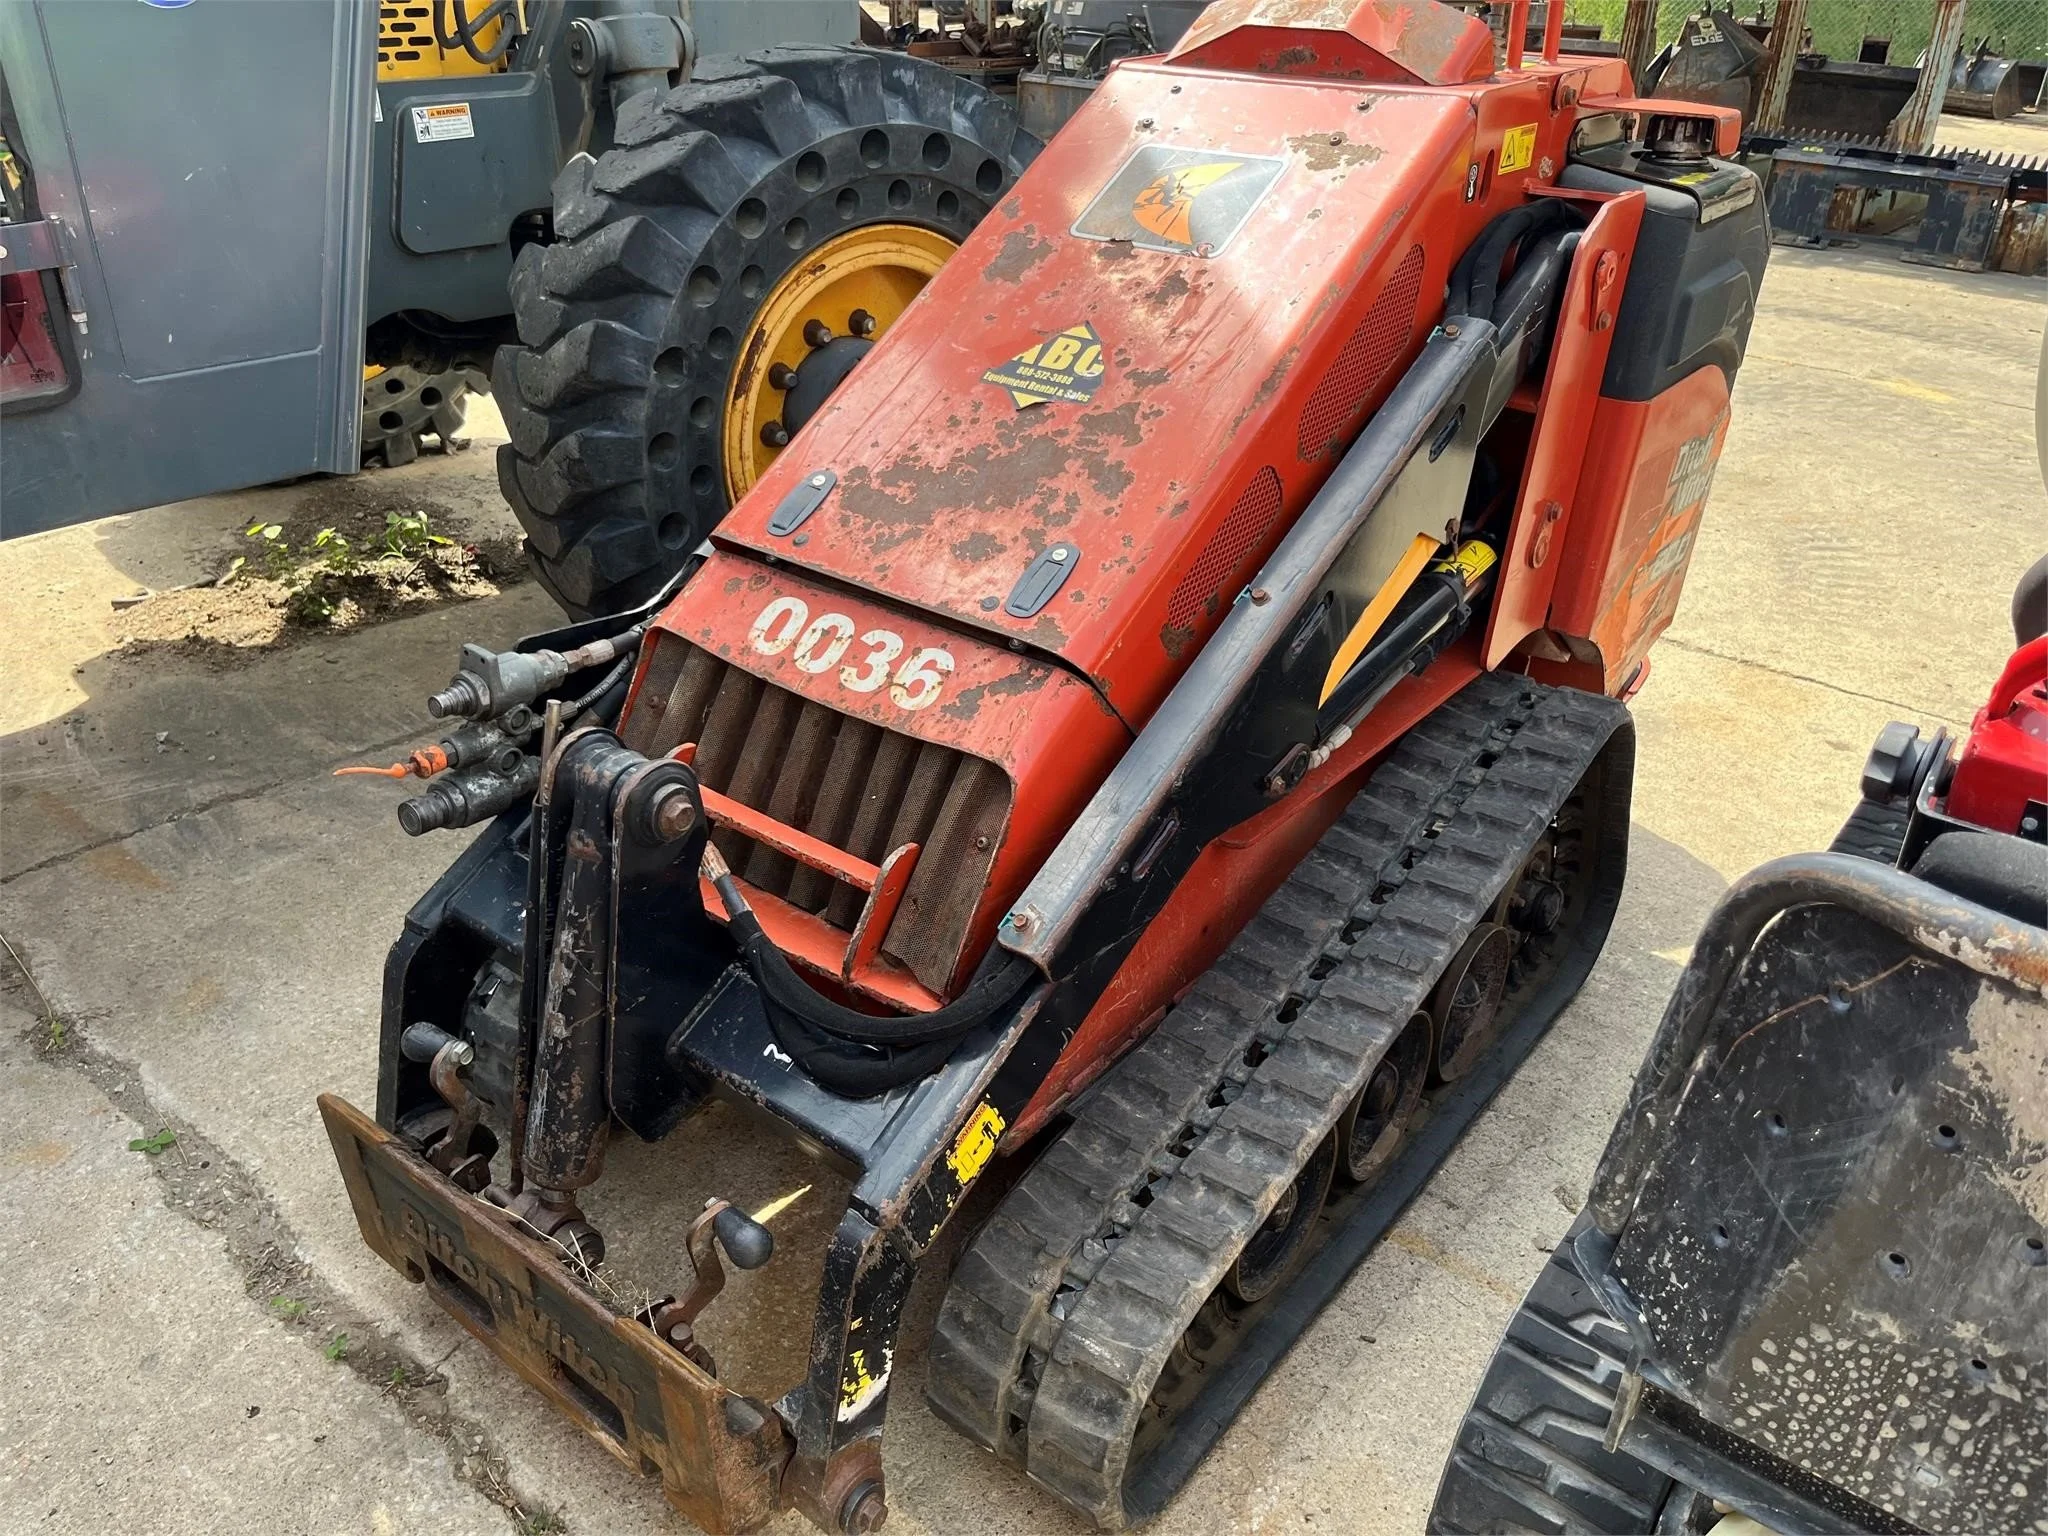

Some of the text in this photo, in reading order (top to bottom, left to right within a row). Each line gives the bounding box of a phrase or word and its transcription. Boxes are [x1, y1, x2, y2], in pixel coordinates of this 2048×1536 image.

[1690, 31, 1724, 46] EDGE
[436, 107, 466, 115] WARNING
[1011, 336, 1104, 378] ABC
[983, 371, 1029, 390] Equipment
[1027, 381, 1058, 396] Rental
[1064, 389, 1091, 402] Sales
[747, 596, 956, 711] 0036
